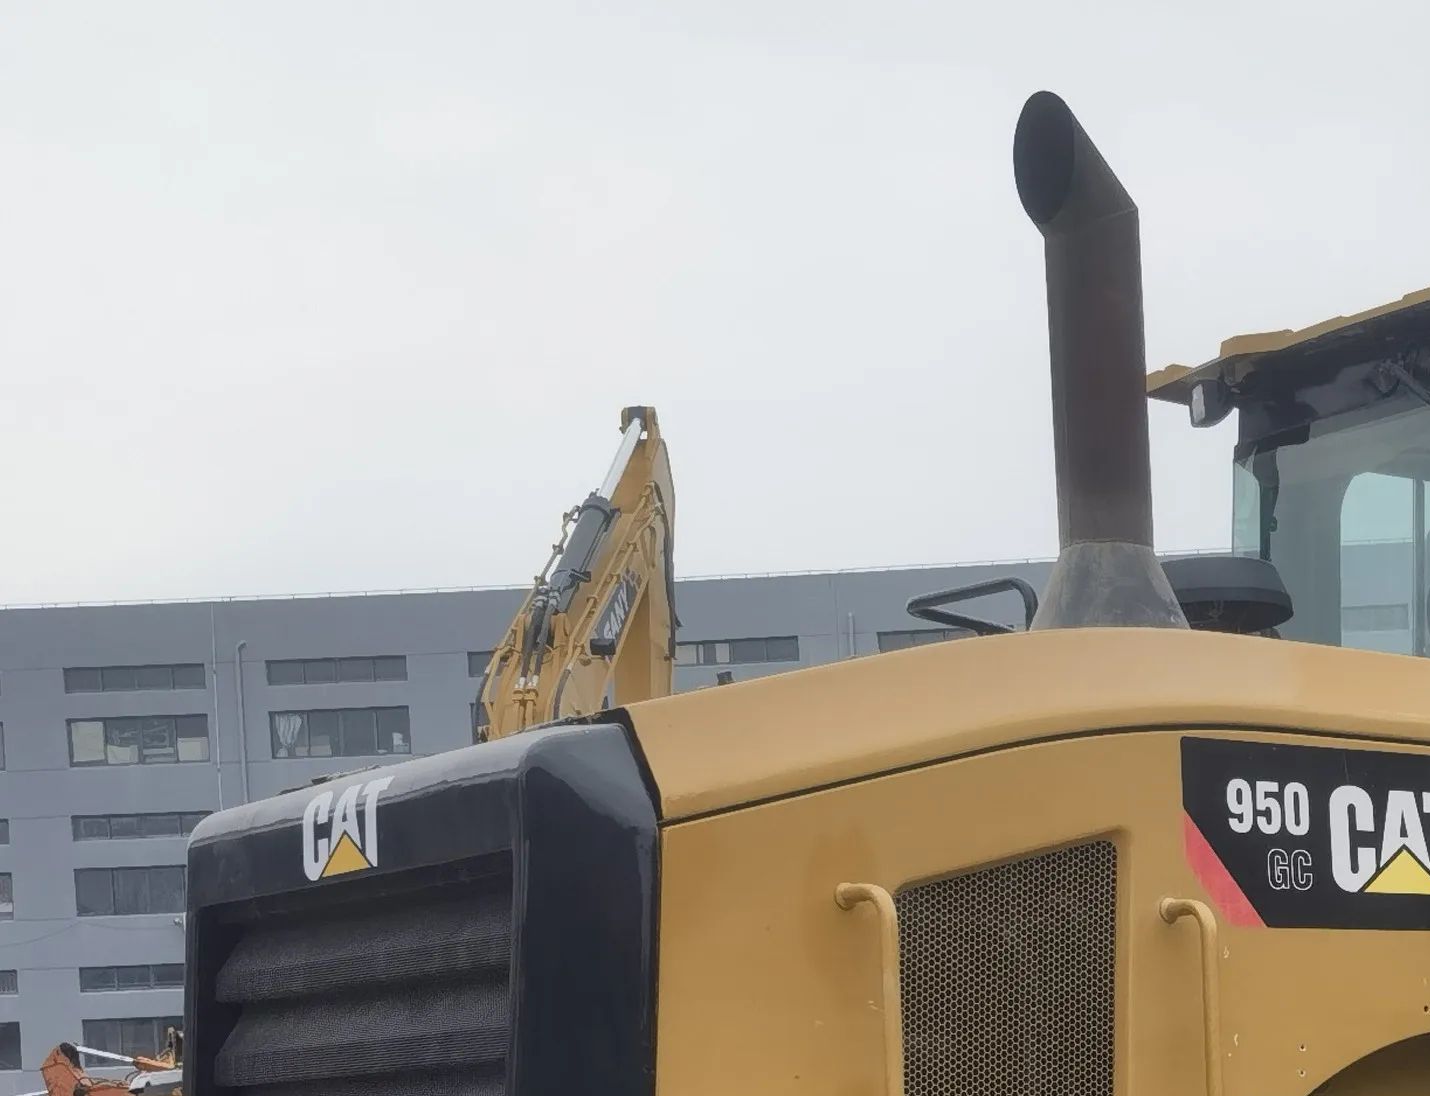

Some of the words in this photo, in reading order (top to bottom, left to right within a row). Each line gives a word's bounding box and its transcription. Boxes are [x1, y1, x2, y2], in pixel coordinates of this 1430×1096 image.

[302, 775, 395, 881] CAT
[1226, 778, 1310, 836] 950
[1267, 849, 1313, 890] GC
